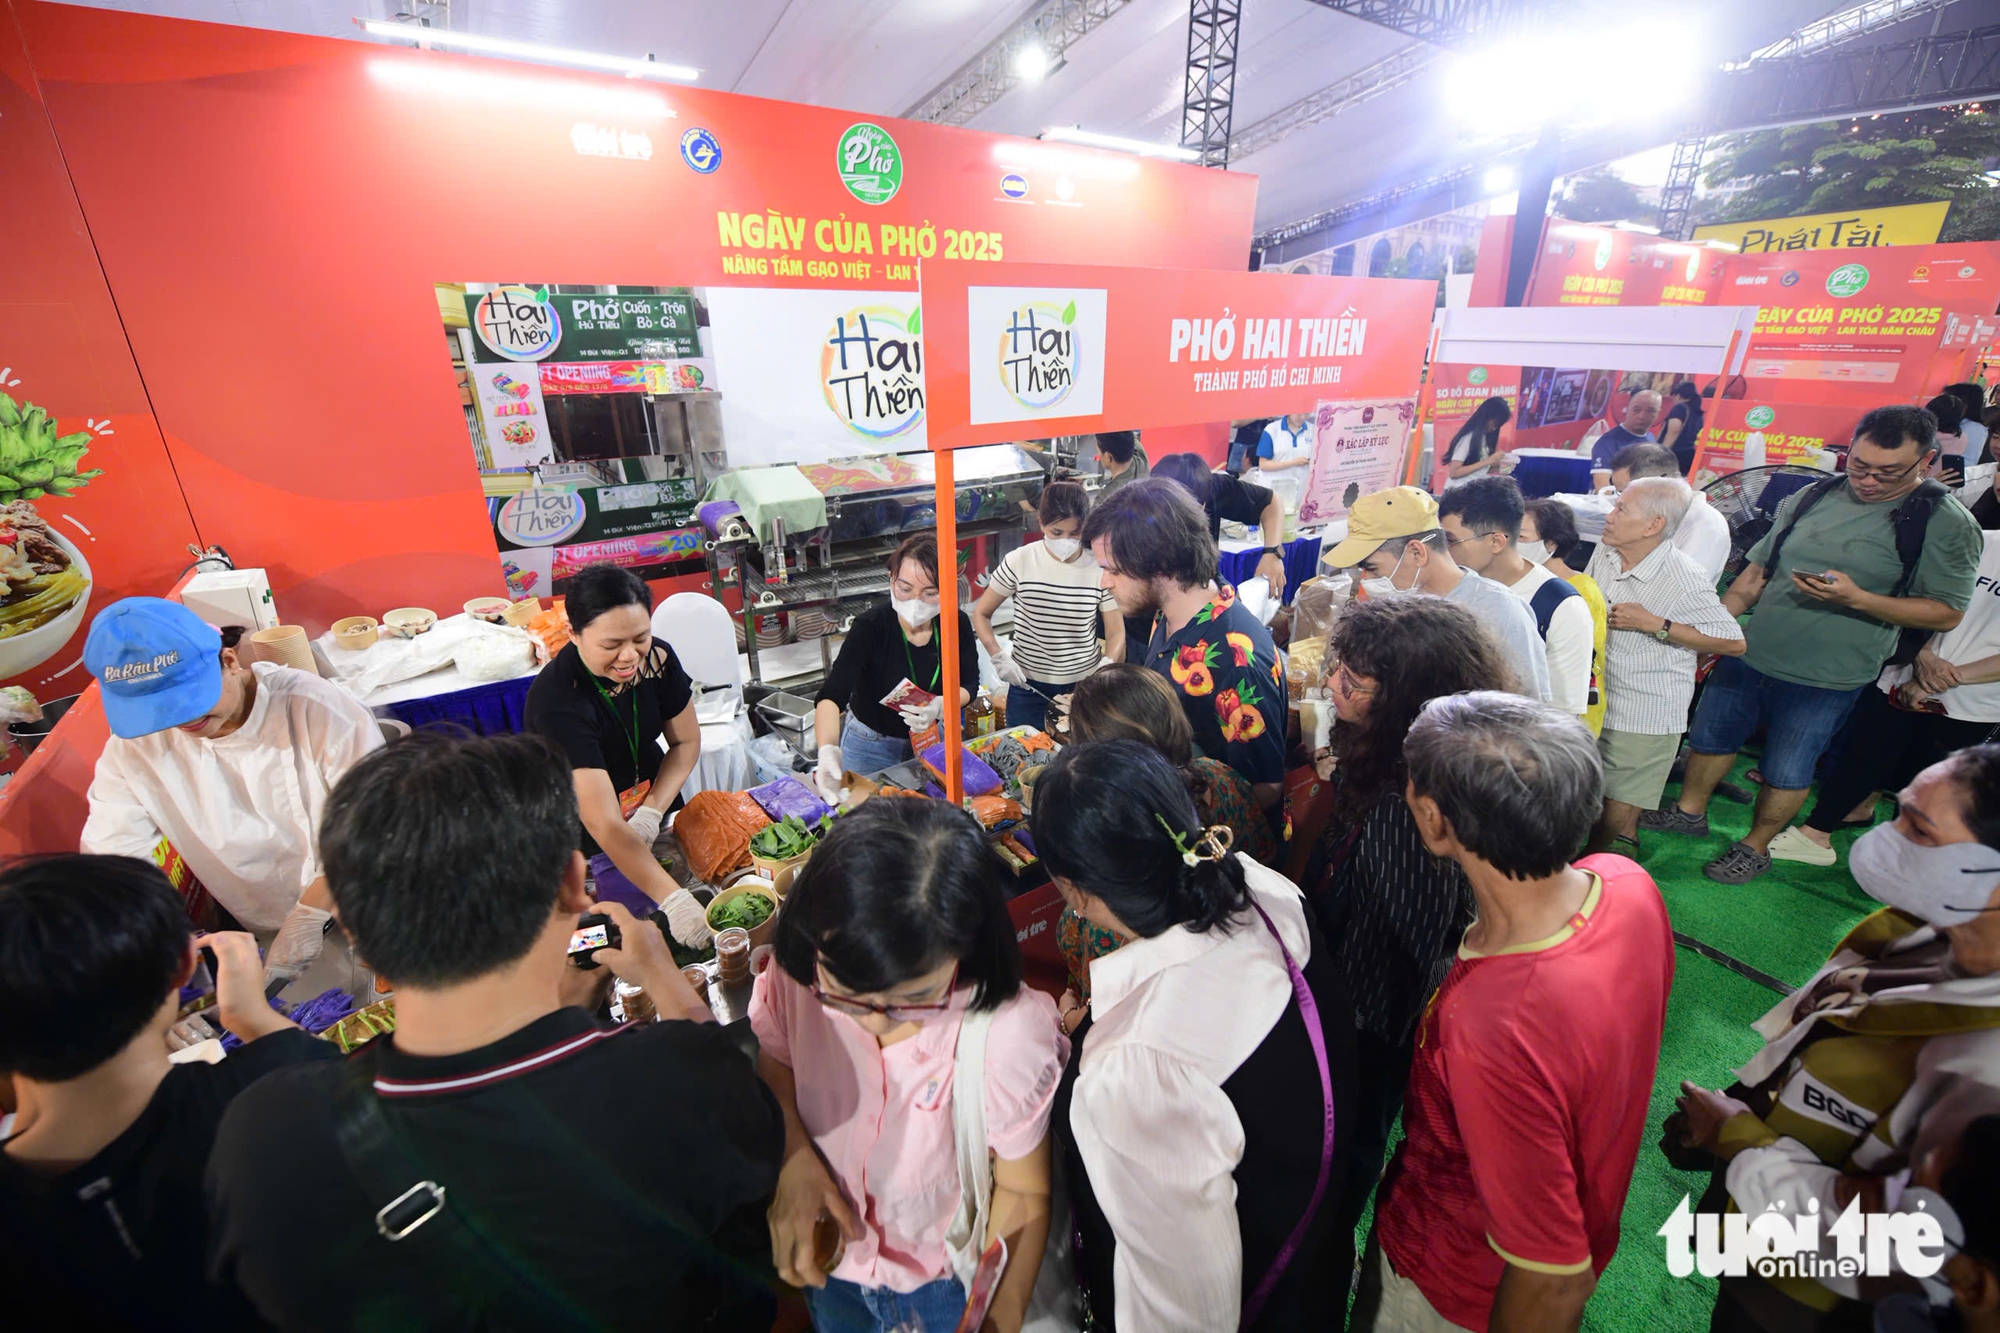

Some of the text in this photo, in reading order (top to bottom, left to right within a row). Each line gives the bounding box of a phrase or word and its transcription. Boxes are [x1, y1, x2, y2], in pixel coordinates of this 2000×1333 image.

[844, 136, 894, 174] Phở
[717, 208, 1004, 262] NGÀY CỦA PHỞ 2025
[1740, 228, 1822, 254] Phát
[722, 253, 768, 275] NÂNG
[771, 254, 803, 277] TẦM
[807, 260, 839, 281] GẠO
[842, 260, 871, 282] VIỆT
[886, 264, 911, 281] LAN
[484, 291, 548, 324] Hai
[572, 298, 686, 320] Phở Cuốn Trộn
[636, 315, 653, 329] Bò
[660, 315, 676, 329] Gà
[1756, 304, 1942, 324] GÀY CỦA PHỞ 2025
[484, 320, 552, 346] Thiền
[829, 313, 921, 375] Hai
[1006, 308, 1071, 357] Hai
[1169, 305, 1368, 362] PHỞ HAI THIỀN
[1003, 354, 1072, 394] Thiền
[1193, 362, 1343, 393] THÀNH PHỐ HỒ CHÍ MINH
[829, 371, 924, 420] Thiền
[1464, 387, 1489, 397] GIAN
[514, 490, 572, 511] Hai
[508, 509, 574, 533] Thiền
